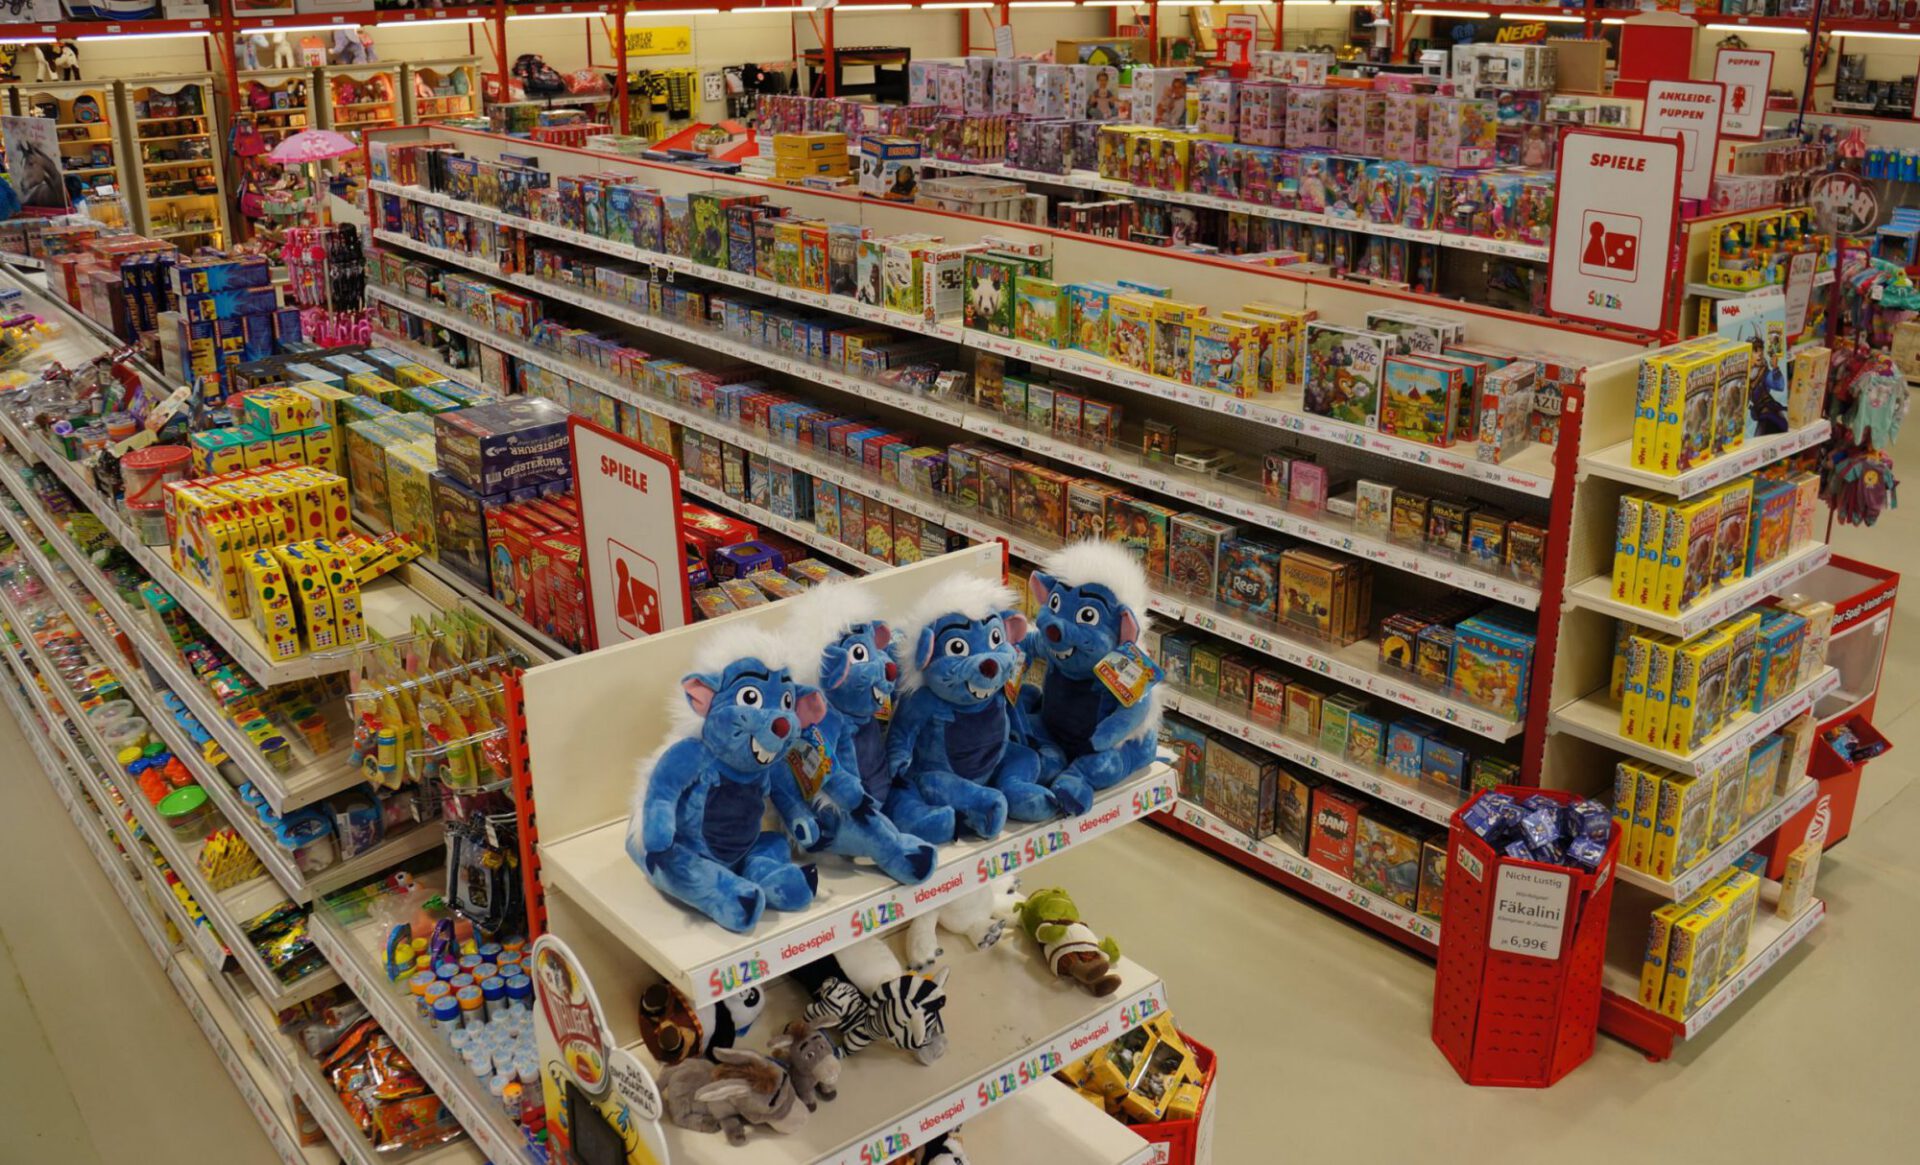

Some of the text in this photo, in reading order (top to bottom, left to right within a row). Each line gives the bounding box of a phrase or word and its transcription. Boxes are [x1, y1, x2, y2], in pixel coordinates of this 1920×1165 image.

[1496, 22, 1546, 43] NERF
[1728, 58, 1760, 67] PUPPEN
[1659, 91, 1715, 104] ANKLEIDE-
[1659, 108, 1704, 120] PUPPEN
[1590, 153, 1647, 172] SPIELE
[1721, 306, 1740, 316] HABA
[1408, 337, 1435, 350] MAZE
[1351, 347, 1377, 365] MAZE
[1533, 395, 1561, 411] AZU
[503, 457, 563, 477] GEISTERUHR
[600, 454, 648, 494] SPIELE
[1232, 576, 1260, 596] Reef
[1257, 683, 1280, 699] BAM!
[1132, 785, 1173, 816] SULZER
[1078, 807, 1120, 833] idee+spiel
[1318, 814, 1349, 834] BAM!
[1024, 829, 1071, 863] SULZER
[914, 873, 964, 904] idee+spiel
[1505, 871, 1562, 889] Nicht Lustig
[850, 900, 905, 939] SULZER
[1499, 899, 1561, 921] Fäkalini
[780, 926, 836, 960] idee+spiel
[1510, 935, 1549, 951] 6,99€
[709, 957, 770, 998] SULZER
[1120, 999, 1160, 1030] SULZER
[1070, 1022, 1110, 1052] idee+spiel
[1017, 1051, 1062, 1086] SULZER
[919, 1099, 965, 1132] idee+spiel
[860, 1132, 911, 1165] SULZER
